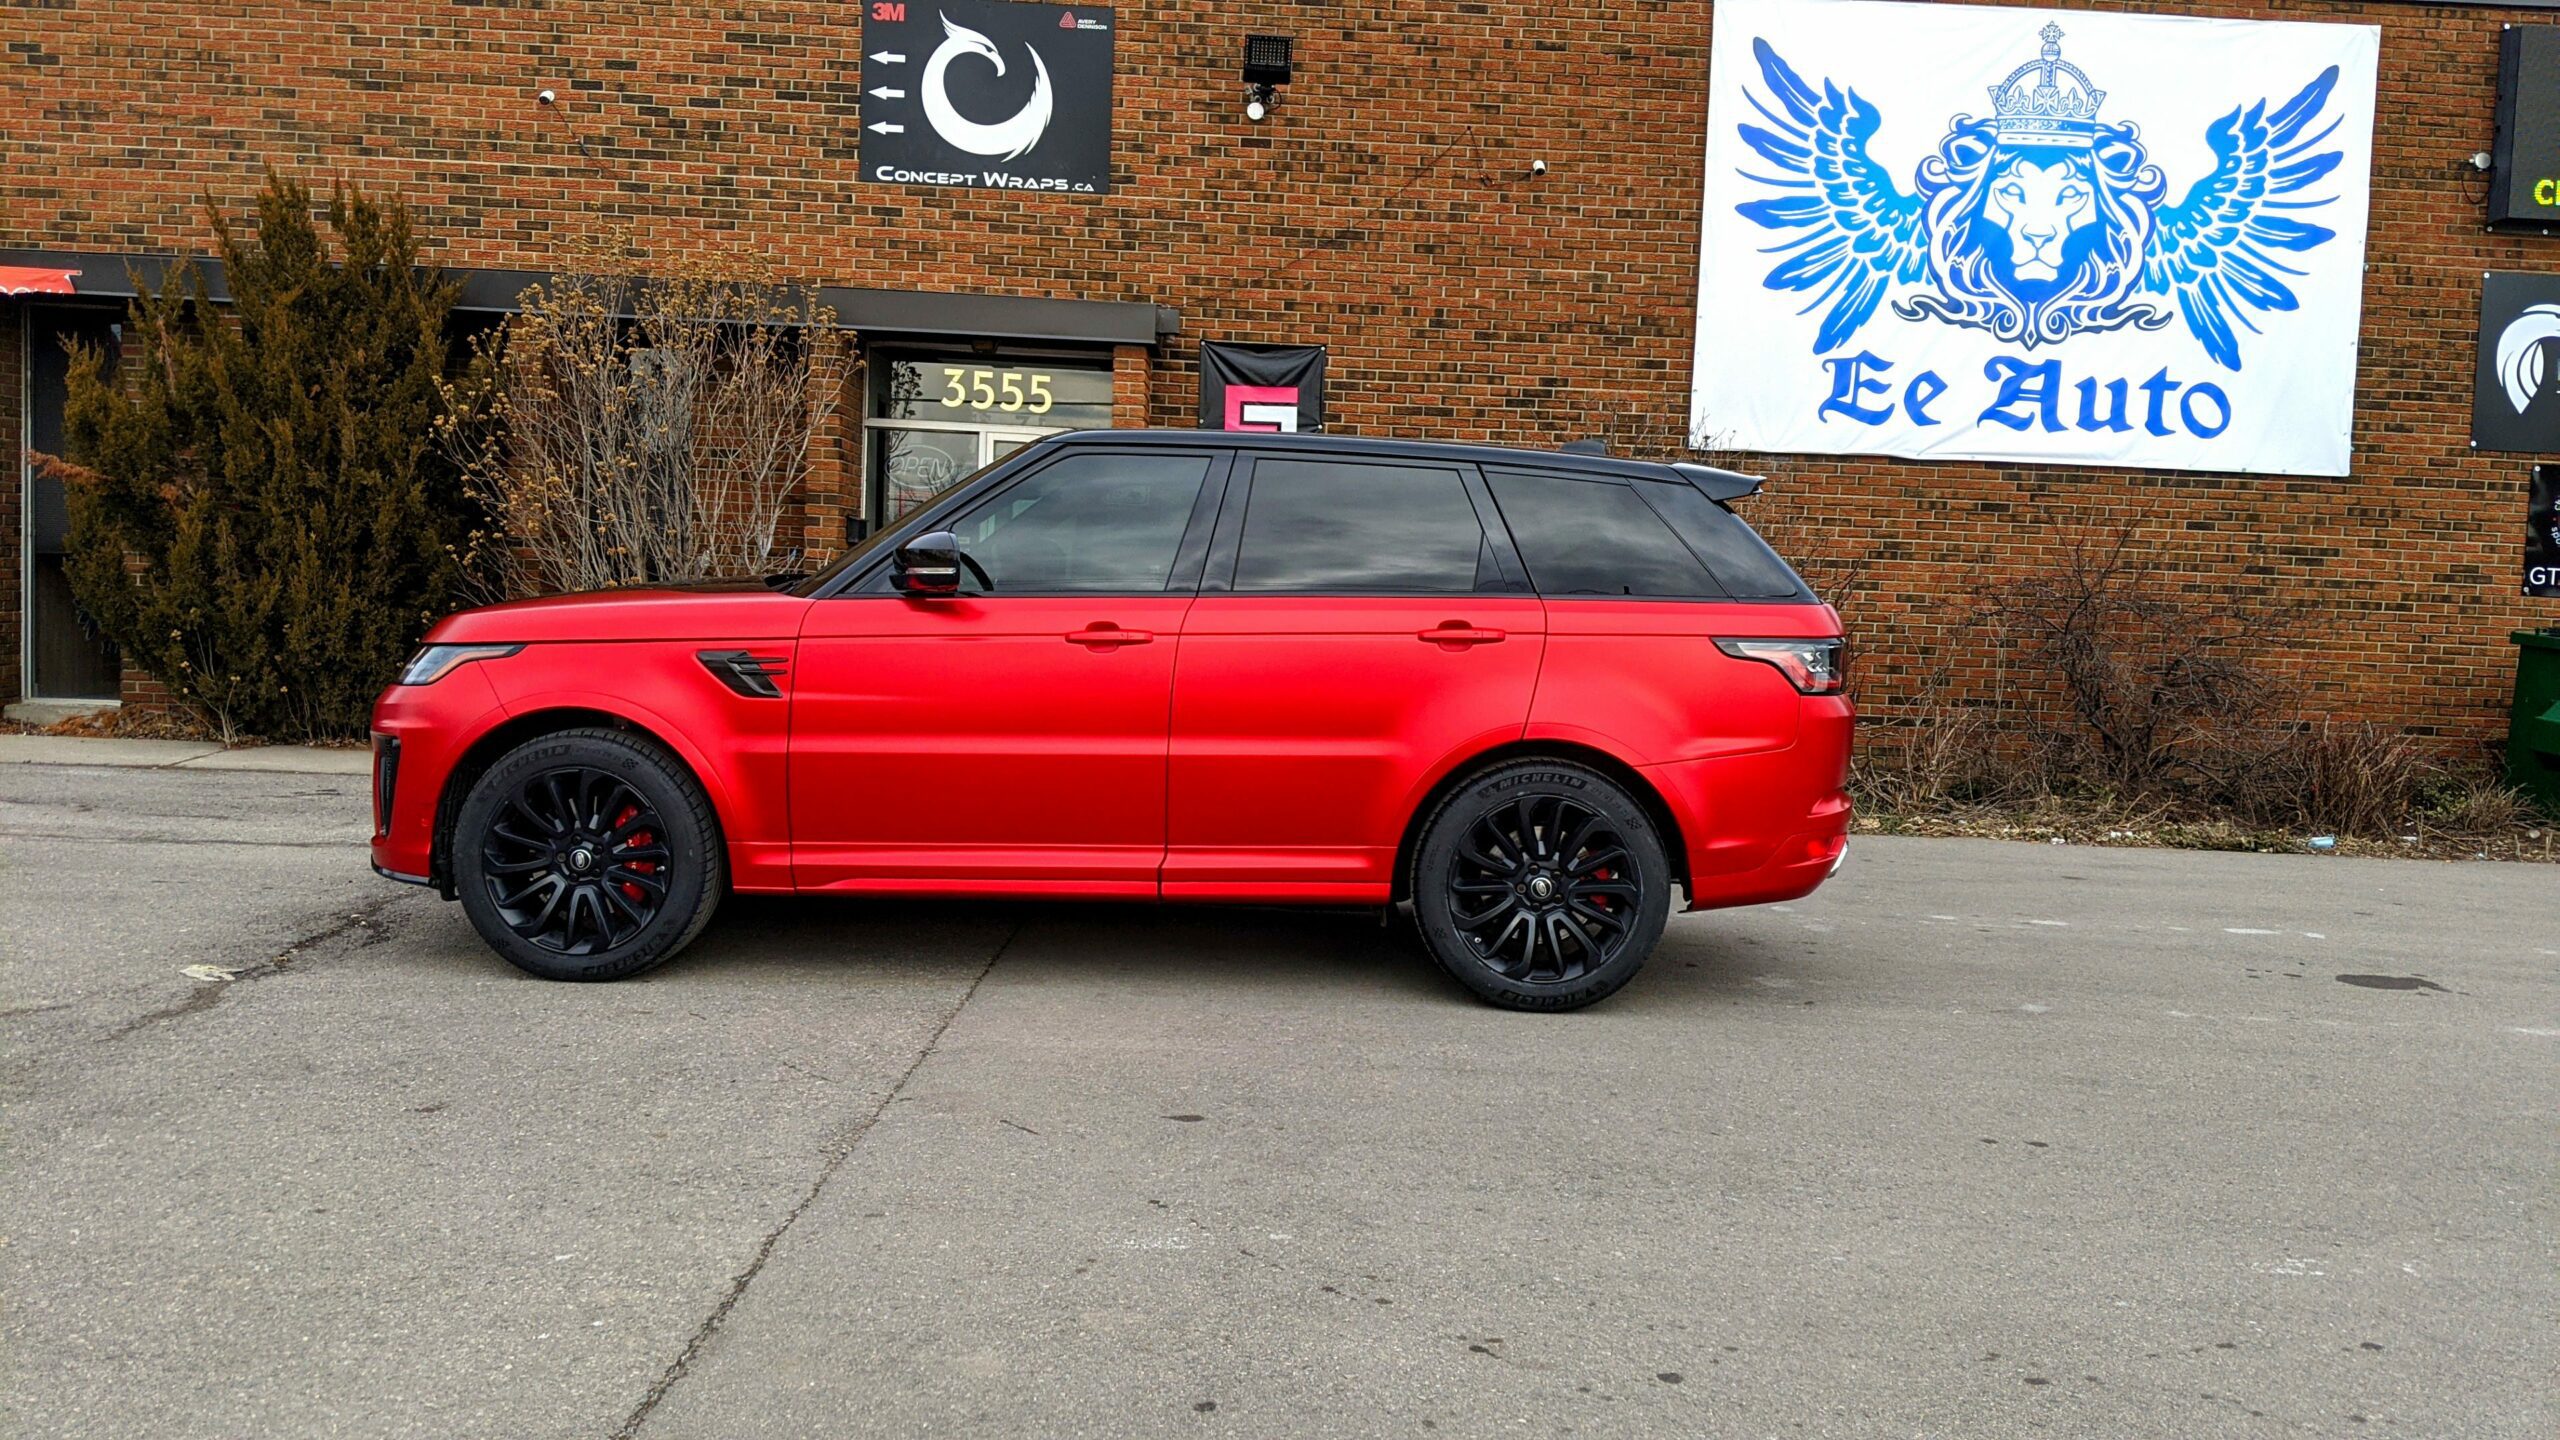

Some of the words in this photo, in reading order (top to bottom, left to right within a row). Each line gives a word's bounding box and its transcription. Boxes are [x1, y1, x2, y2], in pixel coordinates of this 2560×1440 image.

[872, 2, 905, 22] 3M
[876, 166, 977, 186] CONCEPT
[941, 368, 1052, 414] 3555
[1817, 350, 1948, 427] Ee
[1977, 355, 2231, 439] Auto
[889, 456, 948, 479] OPEN
[1499, 773, 1583, 790] MICHELIN
